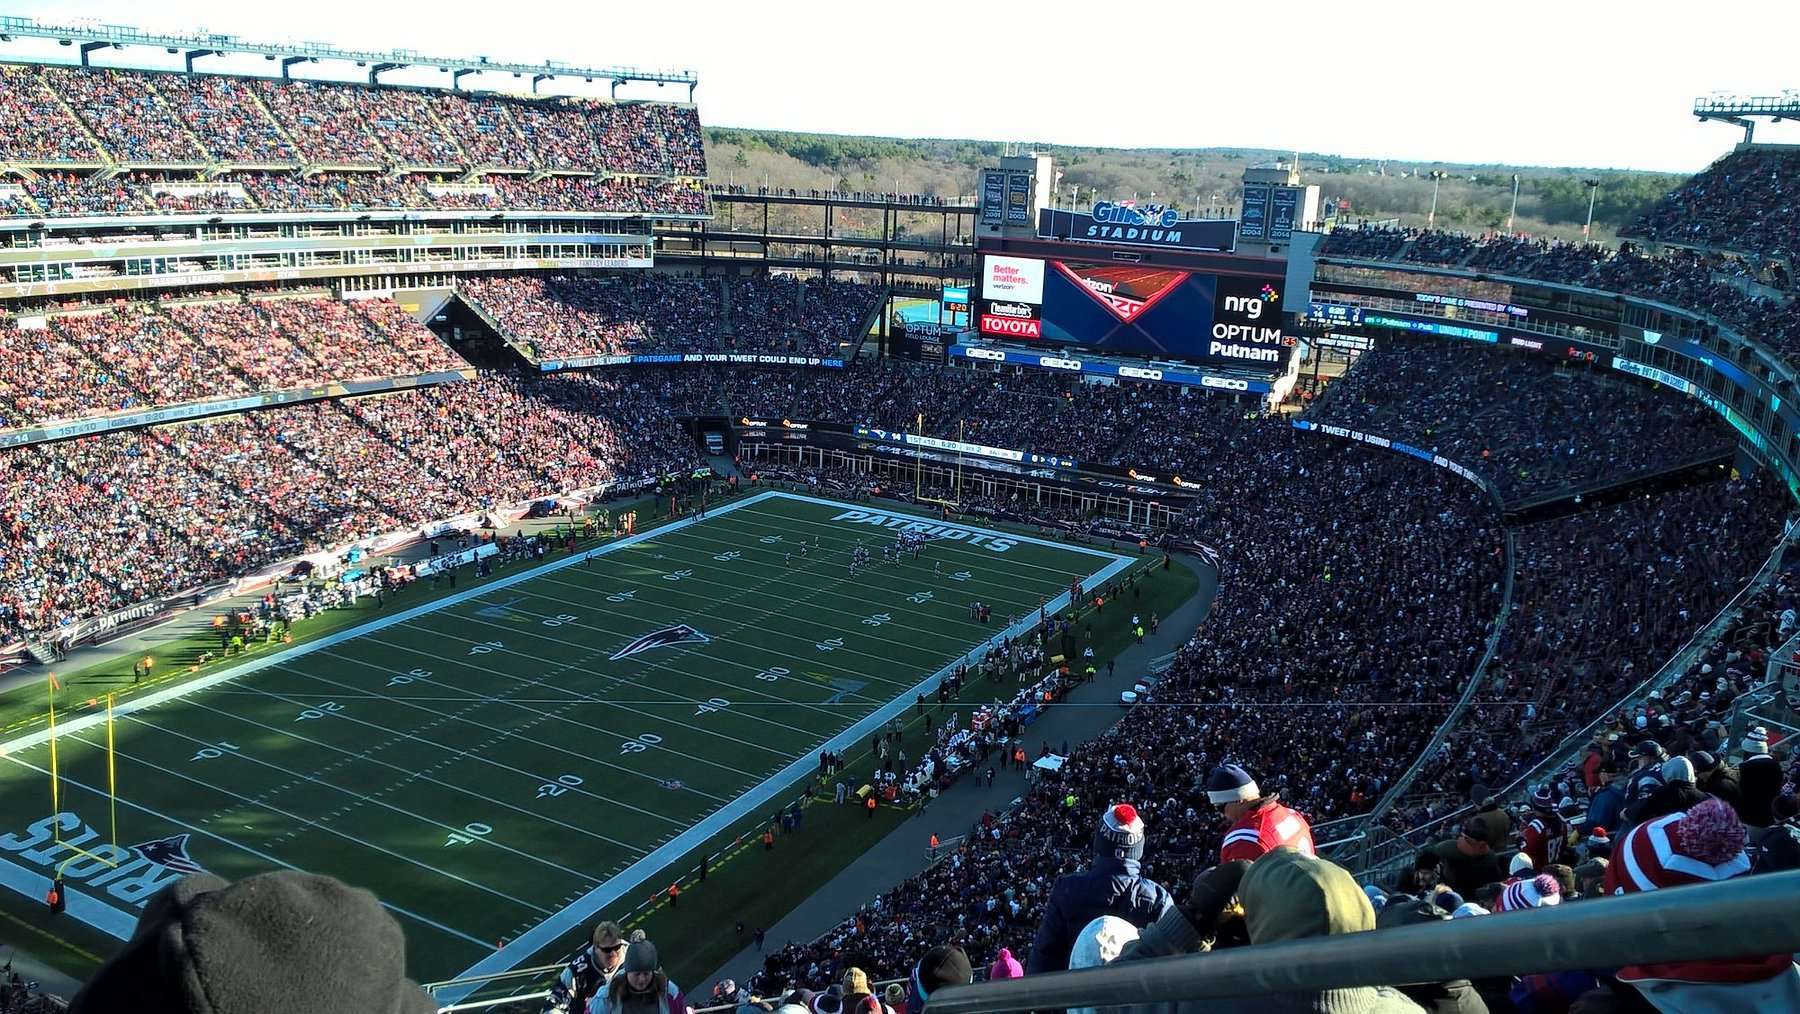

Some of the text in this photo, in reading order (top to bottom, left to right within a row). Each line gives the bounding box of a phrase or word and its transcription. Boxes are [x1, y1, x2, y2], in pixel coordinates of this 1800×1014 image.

[1092, 200, 1178, 228] Gillee
[1087, 225, 1182, 243] STADIUM
[993, 264, 1020, 275] Better
[993, 275, 1029, 285] matters.
[1224, 295, 1262, 319] nrg
[905, 323, 941, 336] OPTUM
[983, 317, 1038, 335] TOYOTA
[1212, 323, 1281, 345] OPTUM
[1283, 337, 1297, 346] 25
[966, 347, 1006, 361] GEICO
[1209, 341, 1279, 362] Putnam
[567, 359, 591, 367] TWEET
[606, 356, 631, 364] USING
[633, 354, 682, 363] #PATSGAME
[684, 354, 702, 362] AND
[704, 354, 727, 362] YOUR
[729, 354, 757, 363] TWEET
[759, 355, 787, 364] COULD
[788, 356, 807, 365] END
[808, 358, 820, 366] UP
[822, 358, 844, 368] HERE
[1039, 356, 1082, 371] GEICO
[1118, 366, 1163, 381] GEICO
[1201, 375, 1249, 391] GEICO
[14, 434, 29, 443] 14
[1321, 424, 1350, 438] TWEET
[1351, 430, 1363, 441] US
[1365, 434, 1390, 448] USING
[1136, 474, 1157, 482] OPTUM
[1180, 481, 1201, 490] OPTUM
[1098, 481, 1168, 496] OPTUM
[830, 510, 1019, 552] PATRIOTS
[760, 535, 783, 544] 10
[713, 550, 741, 562] 20
[663, 569, 692, 581] 30
[949, 571, 972, 582] 10
[606, 591, 634, 602] 40
[906, 591, 933, 604] 20
[99, 602, 155, 631] PATRIOTS
[542, 614, 578, 627] 50
[862, 612, 891, 627] 30
[471, 640, 504, 653] 40
[815, 637, 844, 651] 40
[399, 668, 432, 685] 30
[755, 666, 790, 682] 50
[302, 701, 345, 720] 20
[697, 697, 730, 713] 40
[199, 741, 240, 759] 10
[621, 733, 663, 753] 30
[538, 774, 584, 797] 20
[448, 822, 493, 845] 10
